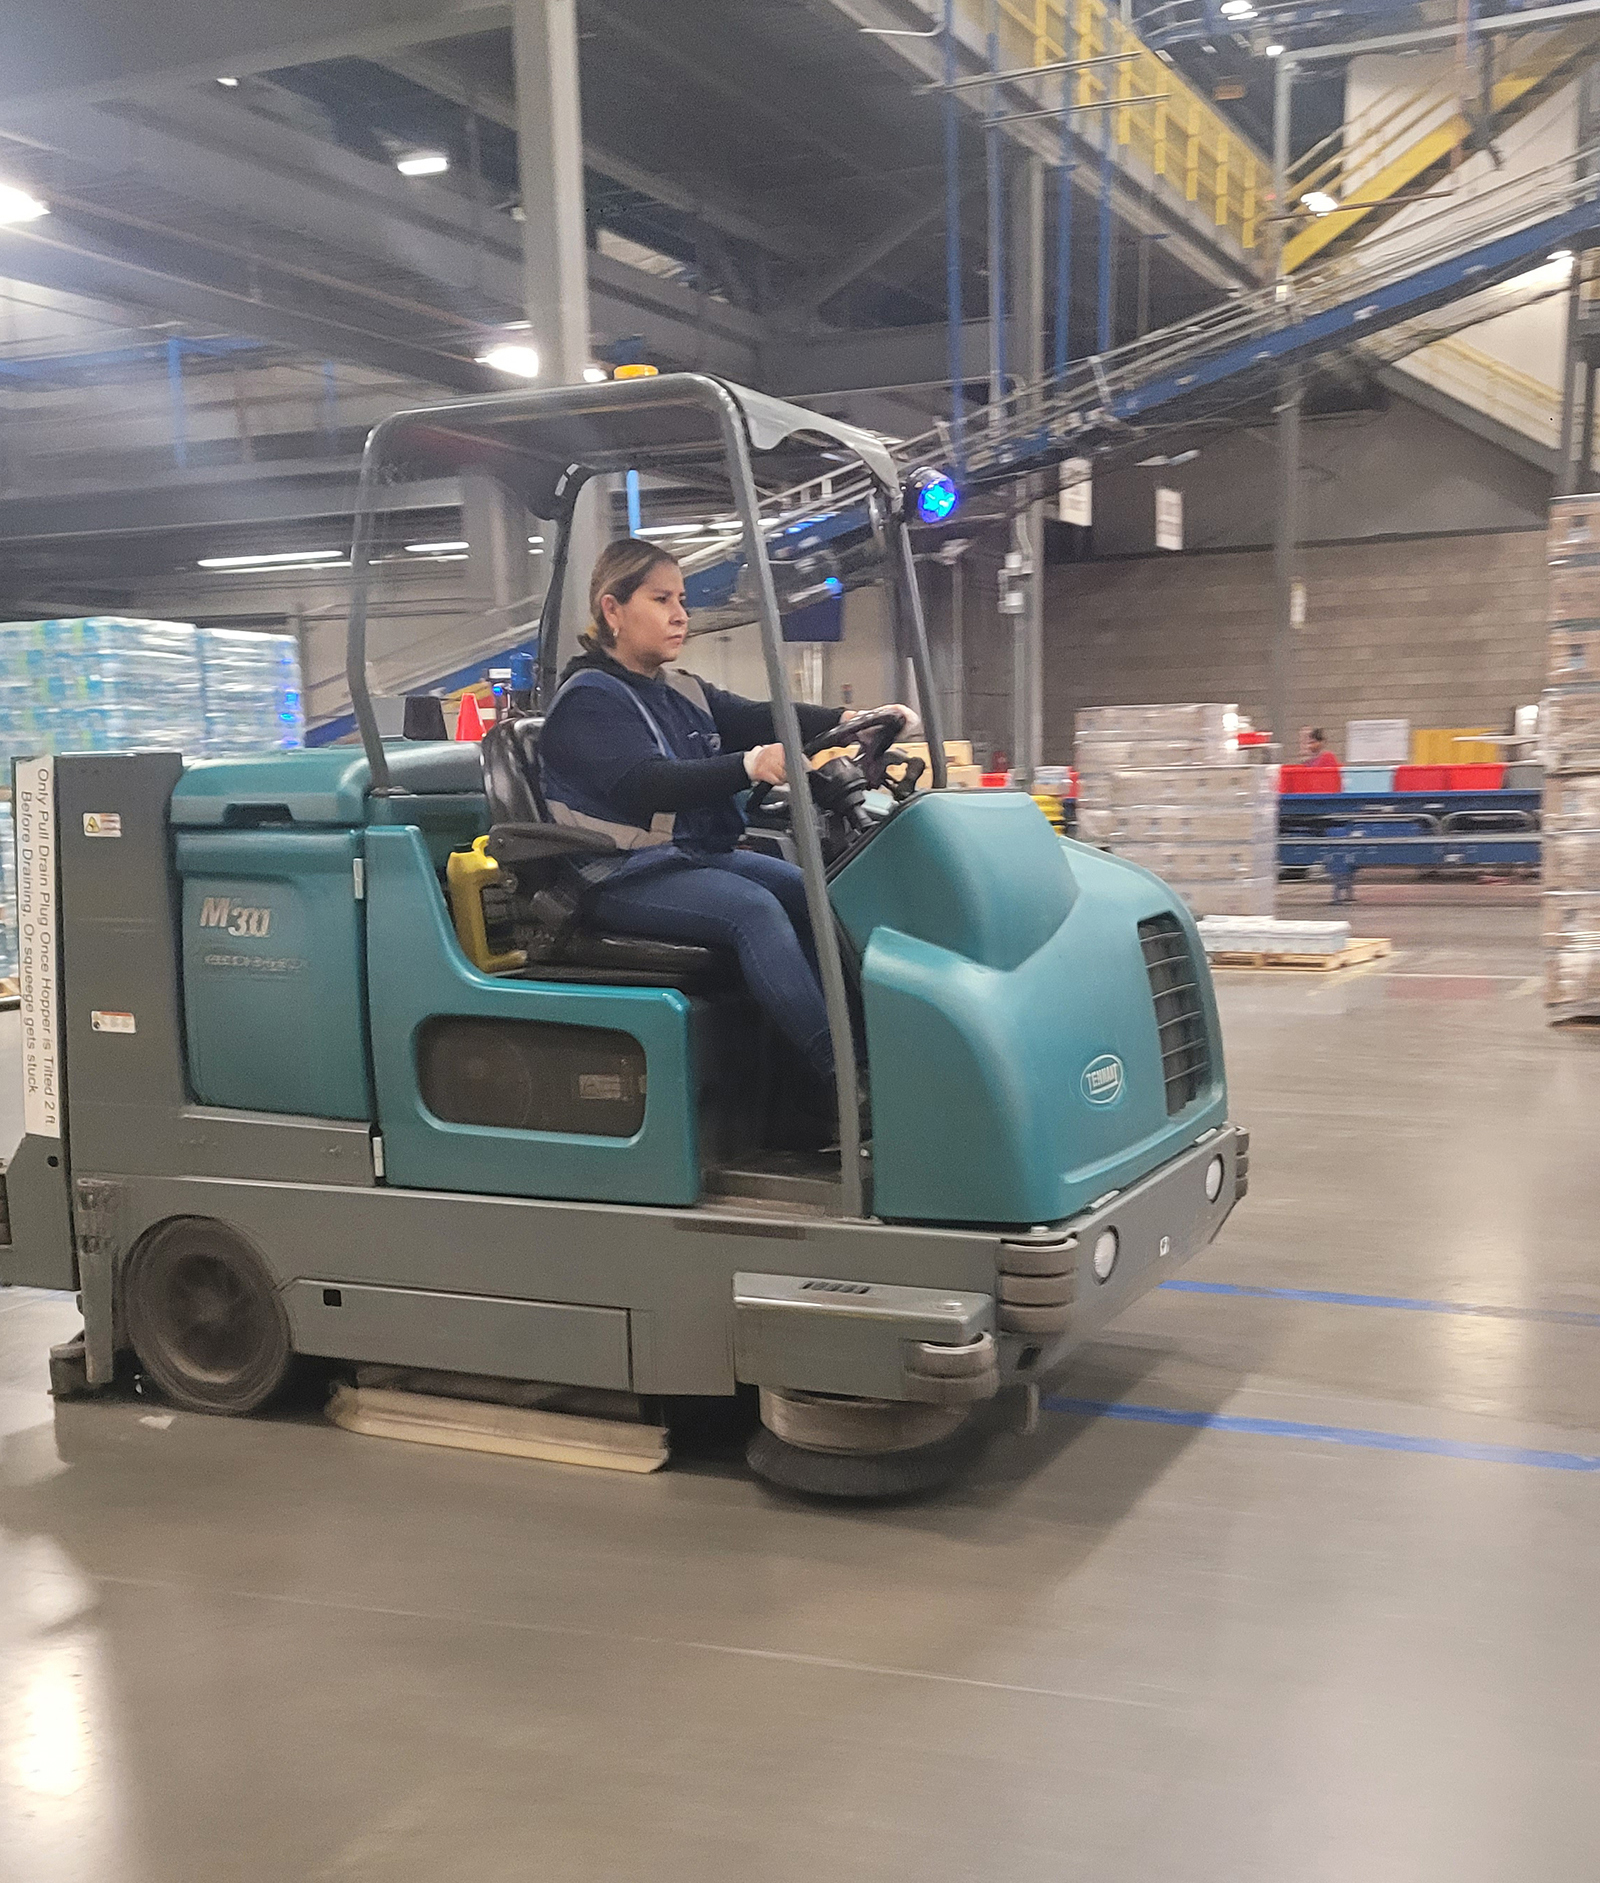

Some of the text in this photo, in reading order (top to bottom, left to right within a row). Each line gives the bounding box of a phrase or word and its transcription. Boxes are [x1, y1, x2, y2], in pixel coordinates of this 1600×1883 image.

[36, 768, 49, 806] Only
[21, 790, 33, 843] Before
[38, 809, 49, 840] Pull
[38, 844, 50, 887] Drain
[37, 891, 51, 927] Plug
[200, 897, 271, 937] M30
[23, 923, 35, 943] Or
[39, 931, 51, 973] Once
[22, 947, 34, 1013] squeege
[39, 977, 52, 1034] Hopper
[23, 1017, 36, 1050] gets
[42, 1037, 53, 1050] is
[43, 1055, 55, 1097] Tilted
[44, 1100, 56, 1111] 2
